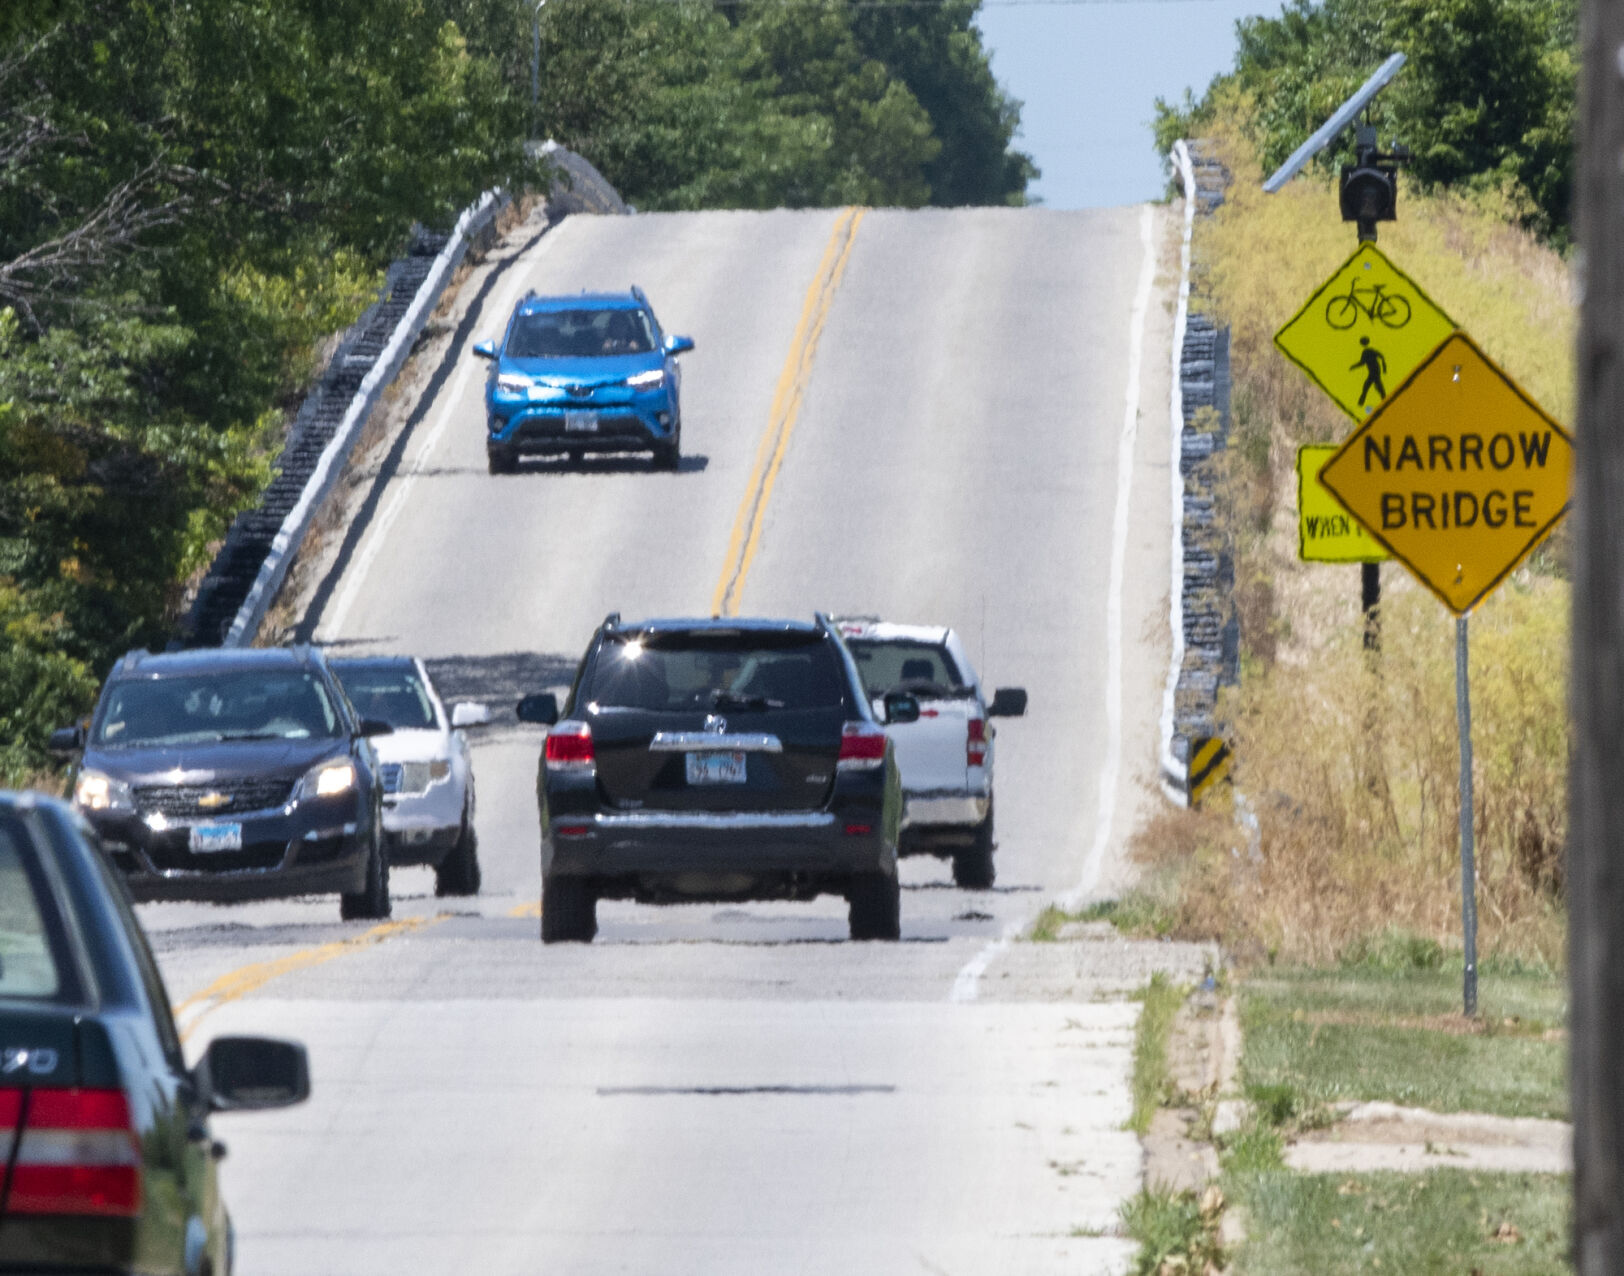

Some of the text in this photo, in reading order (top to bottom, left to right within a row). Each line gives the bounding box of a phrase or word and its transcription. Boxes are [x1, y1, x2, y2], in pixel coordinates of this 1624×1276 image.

[1363, 431, 1551, 472] NARROW
[1306, 514, 1350, 539] WHEN
[1381, 490, 1537, 530] BRIDGE
